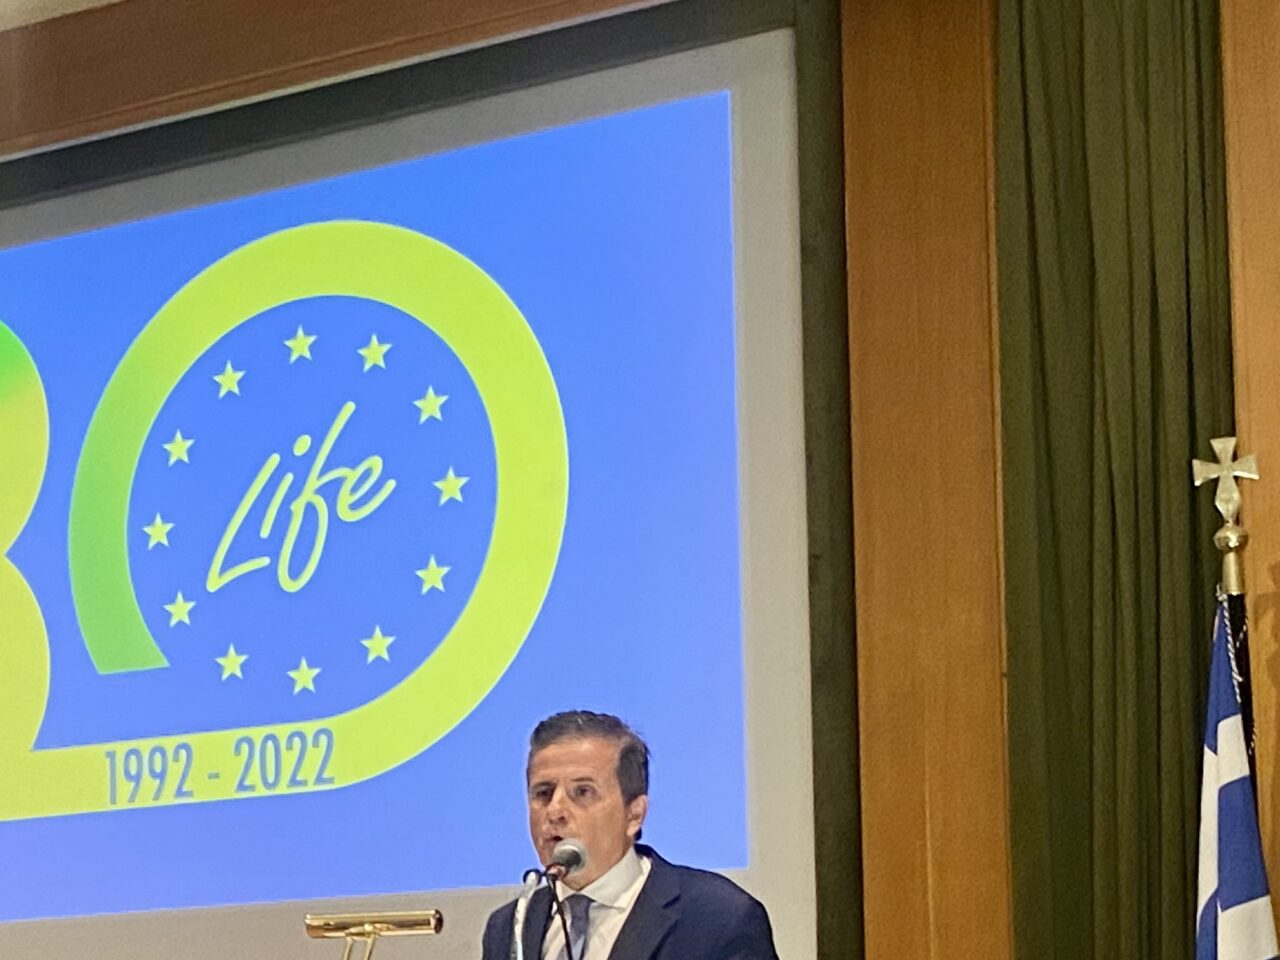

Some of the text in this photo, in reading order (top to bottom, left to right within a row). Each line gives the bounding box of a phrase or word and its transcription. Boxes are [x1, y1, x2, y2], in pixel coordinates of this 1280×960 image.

[206, 400, 396, 592] Life
[105, 742, 194, 805] 1992
[233, 727, 335, 793] 2022
